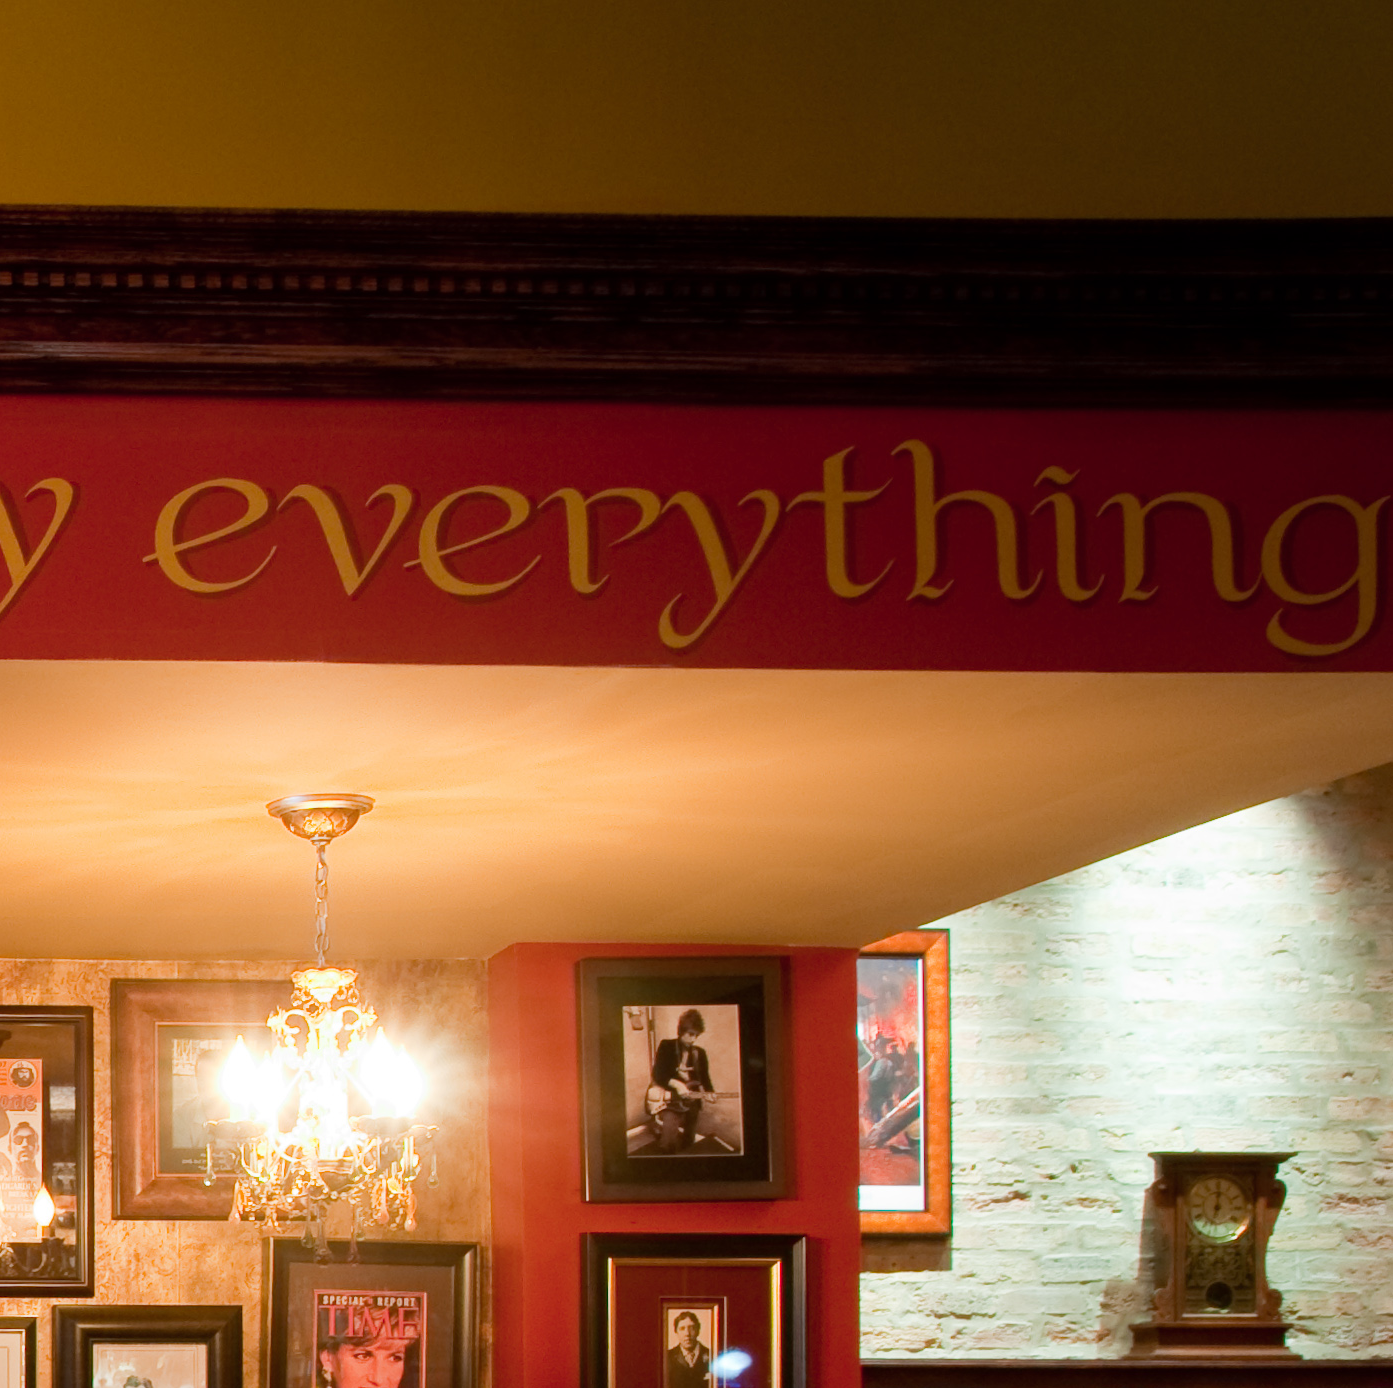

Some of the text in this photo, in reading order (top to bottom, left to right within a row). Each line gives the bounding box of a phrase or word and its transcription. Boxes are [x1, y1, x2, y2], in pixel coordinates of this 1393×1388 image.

[141, 438, 1391, 657] everything
[322, 1294, 416, 1308] SPECIAL REPORT
[318, 1304, 419, 1339] TIME
